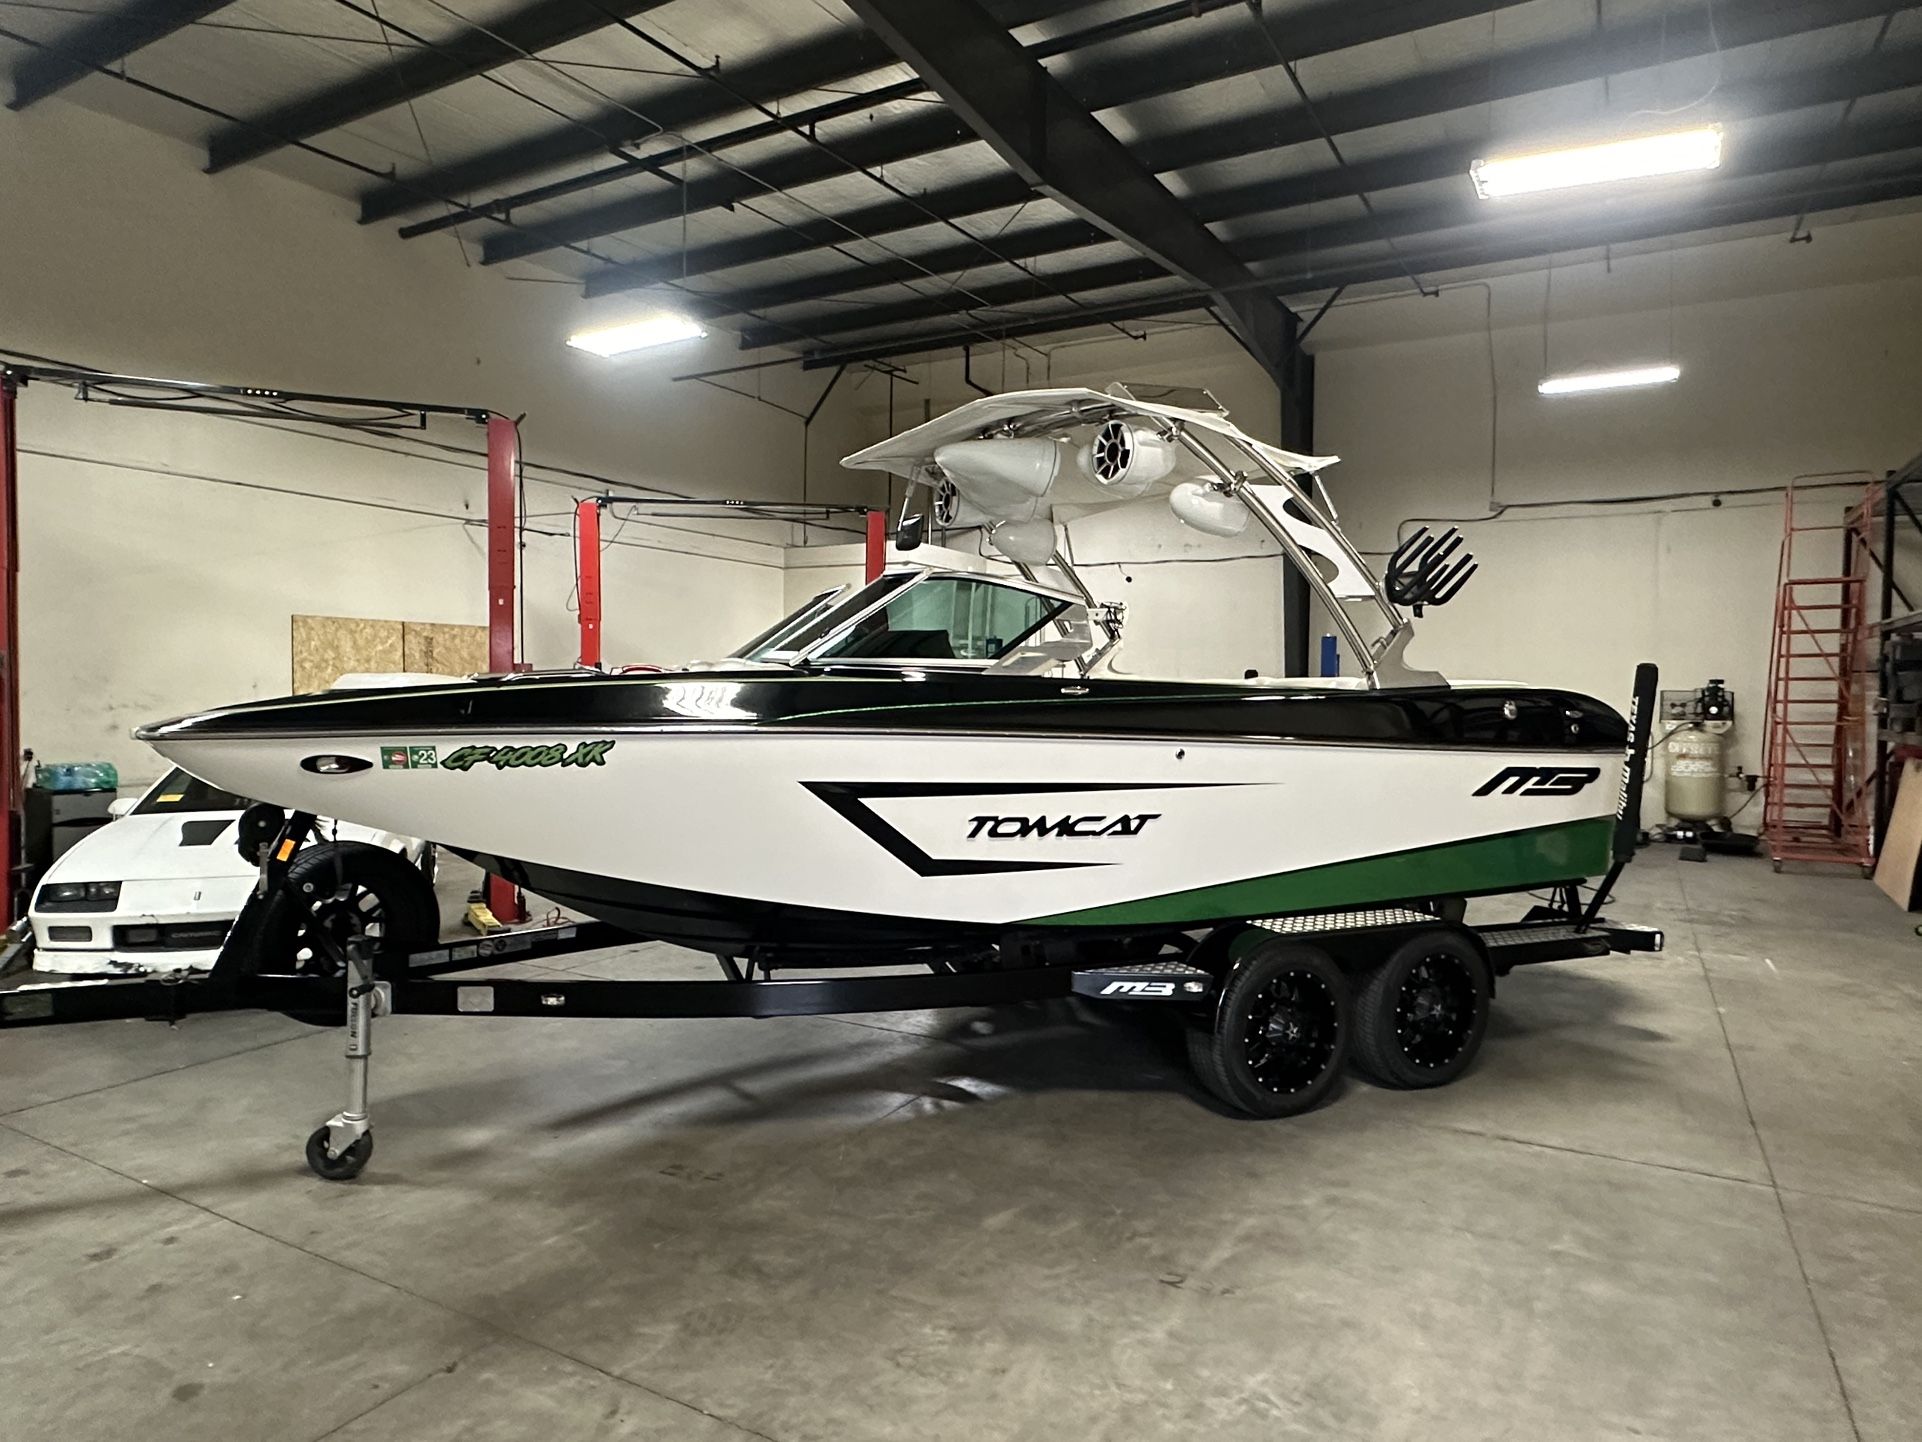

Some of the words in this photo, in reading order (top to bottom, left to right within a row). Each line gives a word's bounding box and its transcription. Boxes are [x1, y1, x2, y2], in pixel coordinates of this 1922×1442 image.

[1627, 696, 1639, 743] TEXAS
[418, 750, 437, 764] 23
[440, 745, 497, 771] CF
[488, 743, 567, 770] 4008
[561, 740, 616, 767] XK
[967, 814, 1162, 838] TOMCAT
